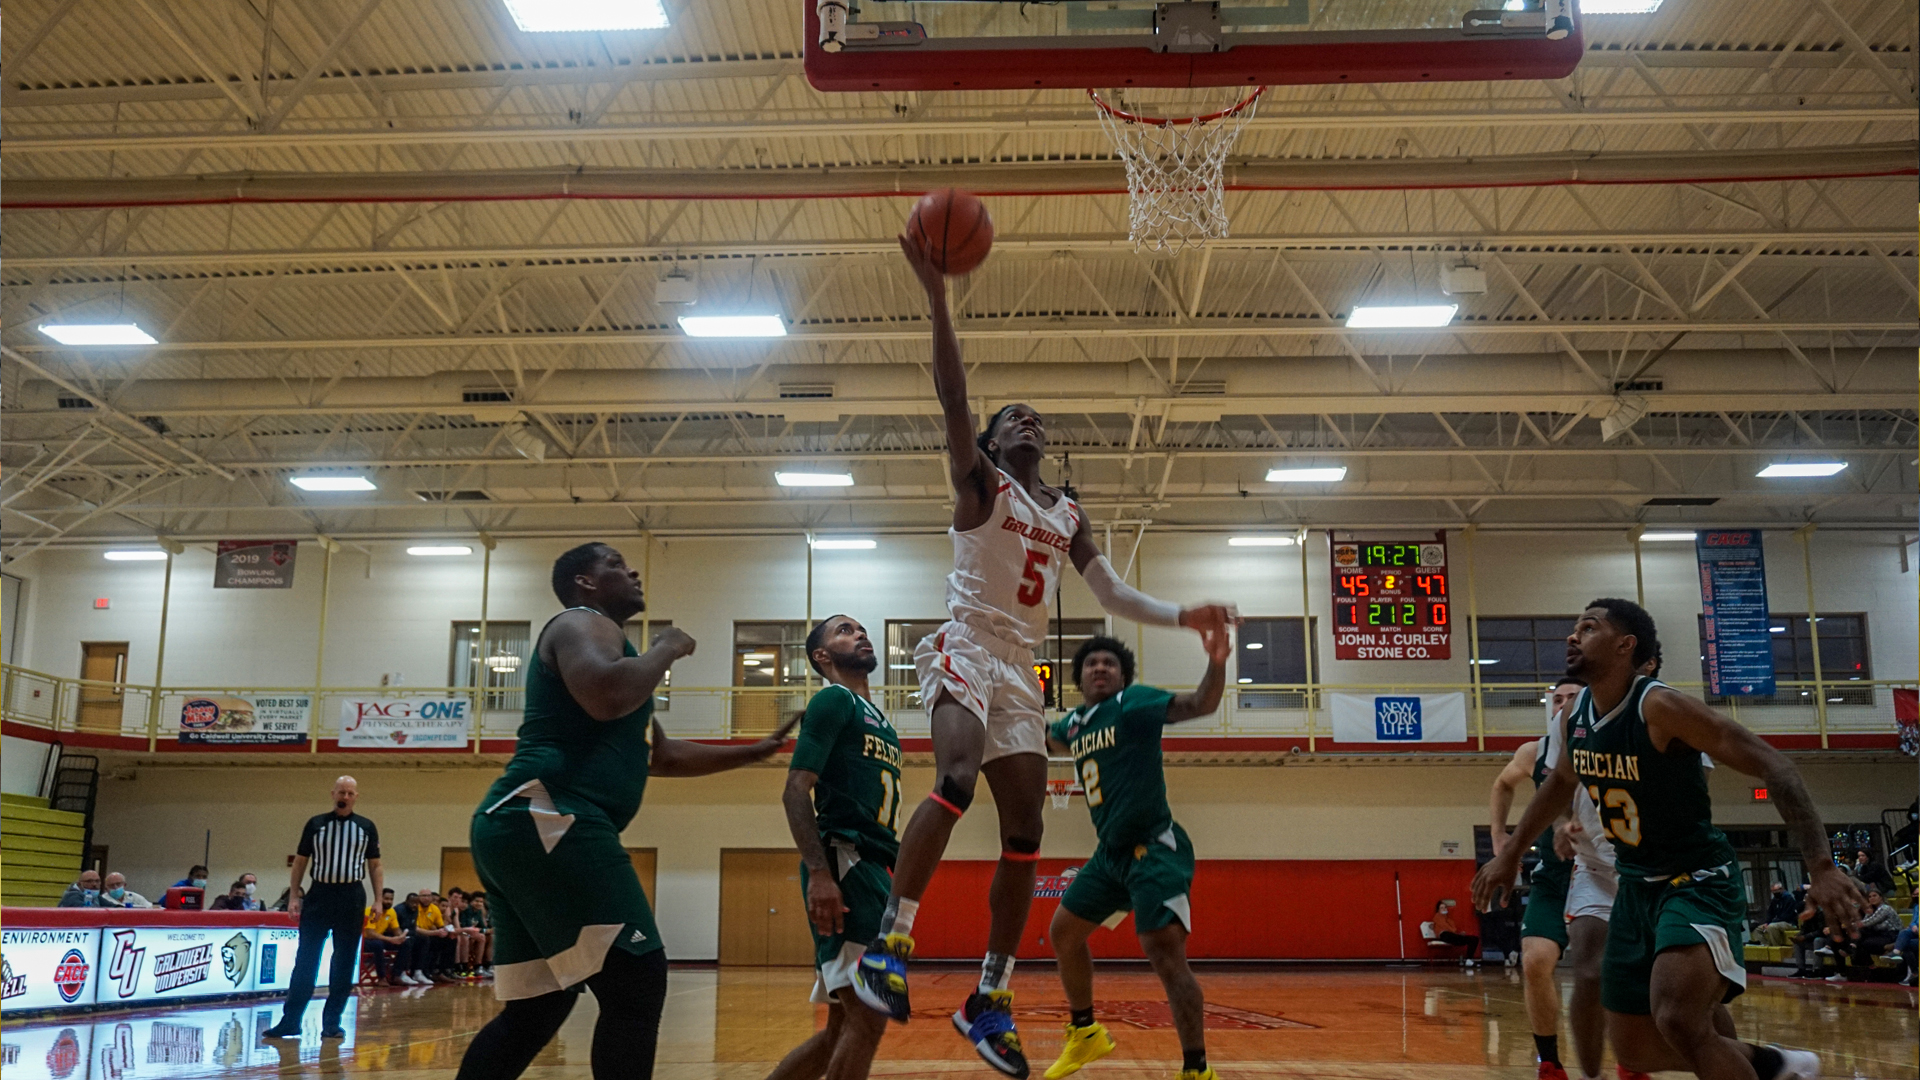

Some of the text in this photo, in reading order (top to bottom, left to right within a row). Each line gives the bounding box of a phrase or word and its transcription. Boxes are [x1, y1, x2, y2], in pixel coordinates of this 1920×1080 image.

[1706, 533, 1751, 546] CACC
[231, 554, 260, 564] 2019
[1367, 545, 1419, 566] 19:27
[227, 577, 284, 585] CHAMPIONS
[1017, 548, 1050, 608] 5
[1341, 575, 1369, 596] 45
[1385, 575, 1395, 588] 2
[1417, 575, 1445, 595] 47
[1351, 605, 1356, 624] 1
[1433, 604, 1447, 625] 0
[1338, 634, 1448, 645] JOHN J. CURLEY
[1357, 647, 1430, 658] STONE CO.
[256, 699, 309, 707] VOTED BEST SUB
[1382, 702, 1413, 712] NEW
[345, 701, 466, 731] JAG-ONE
[1378, 711, 1418, 725] YORK
[263, 722, 298, 730] WE SERVE!
[1383, 723, 1414, 735] LIFE
[1070, 725, 1116, 760] ELICIAN
[862, 734, 902, 768] FELICI
[2, 932, 89, 944] ENVIRONMENT
[270, 931, 298, 940] SUPPOR
[154, 944, 213, 976] CALDWELL
[54, 964, 89, 983] CACC
[155, 963, 210, 993] UNIVERSITY
[1, 976, 27, 998] ELL
